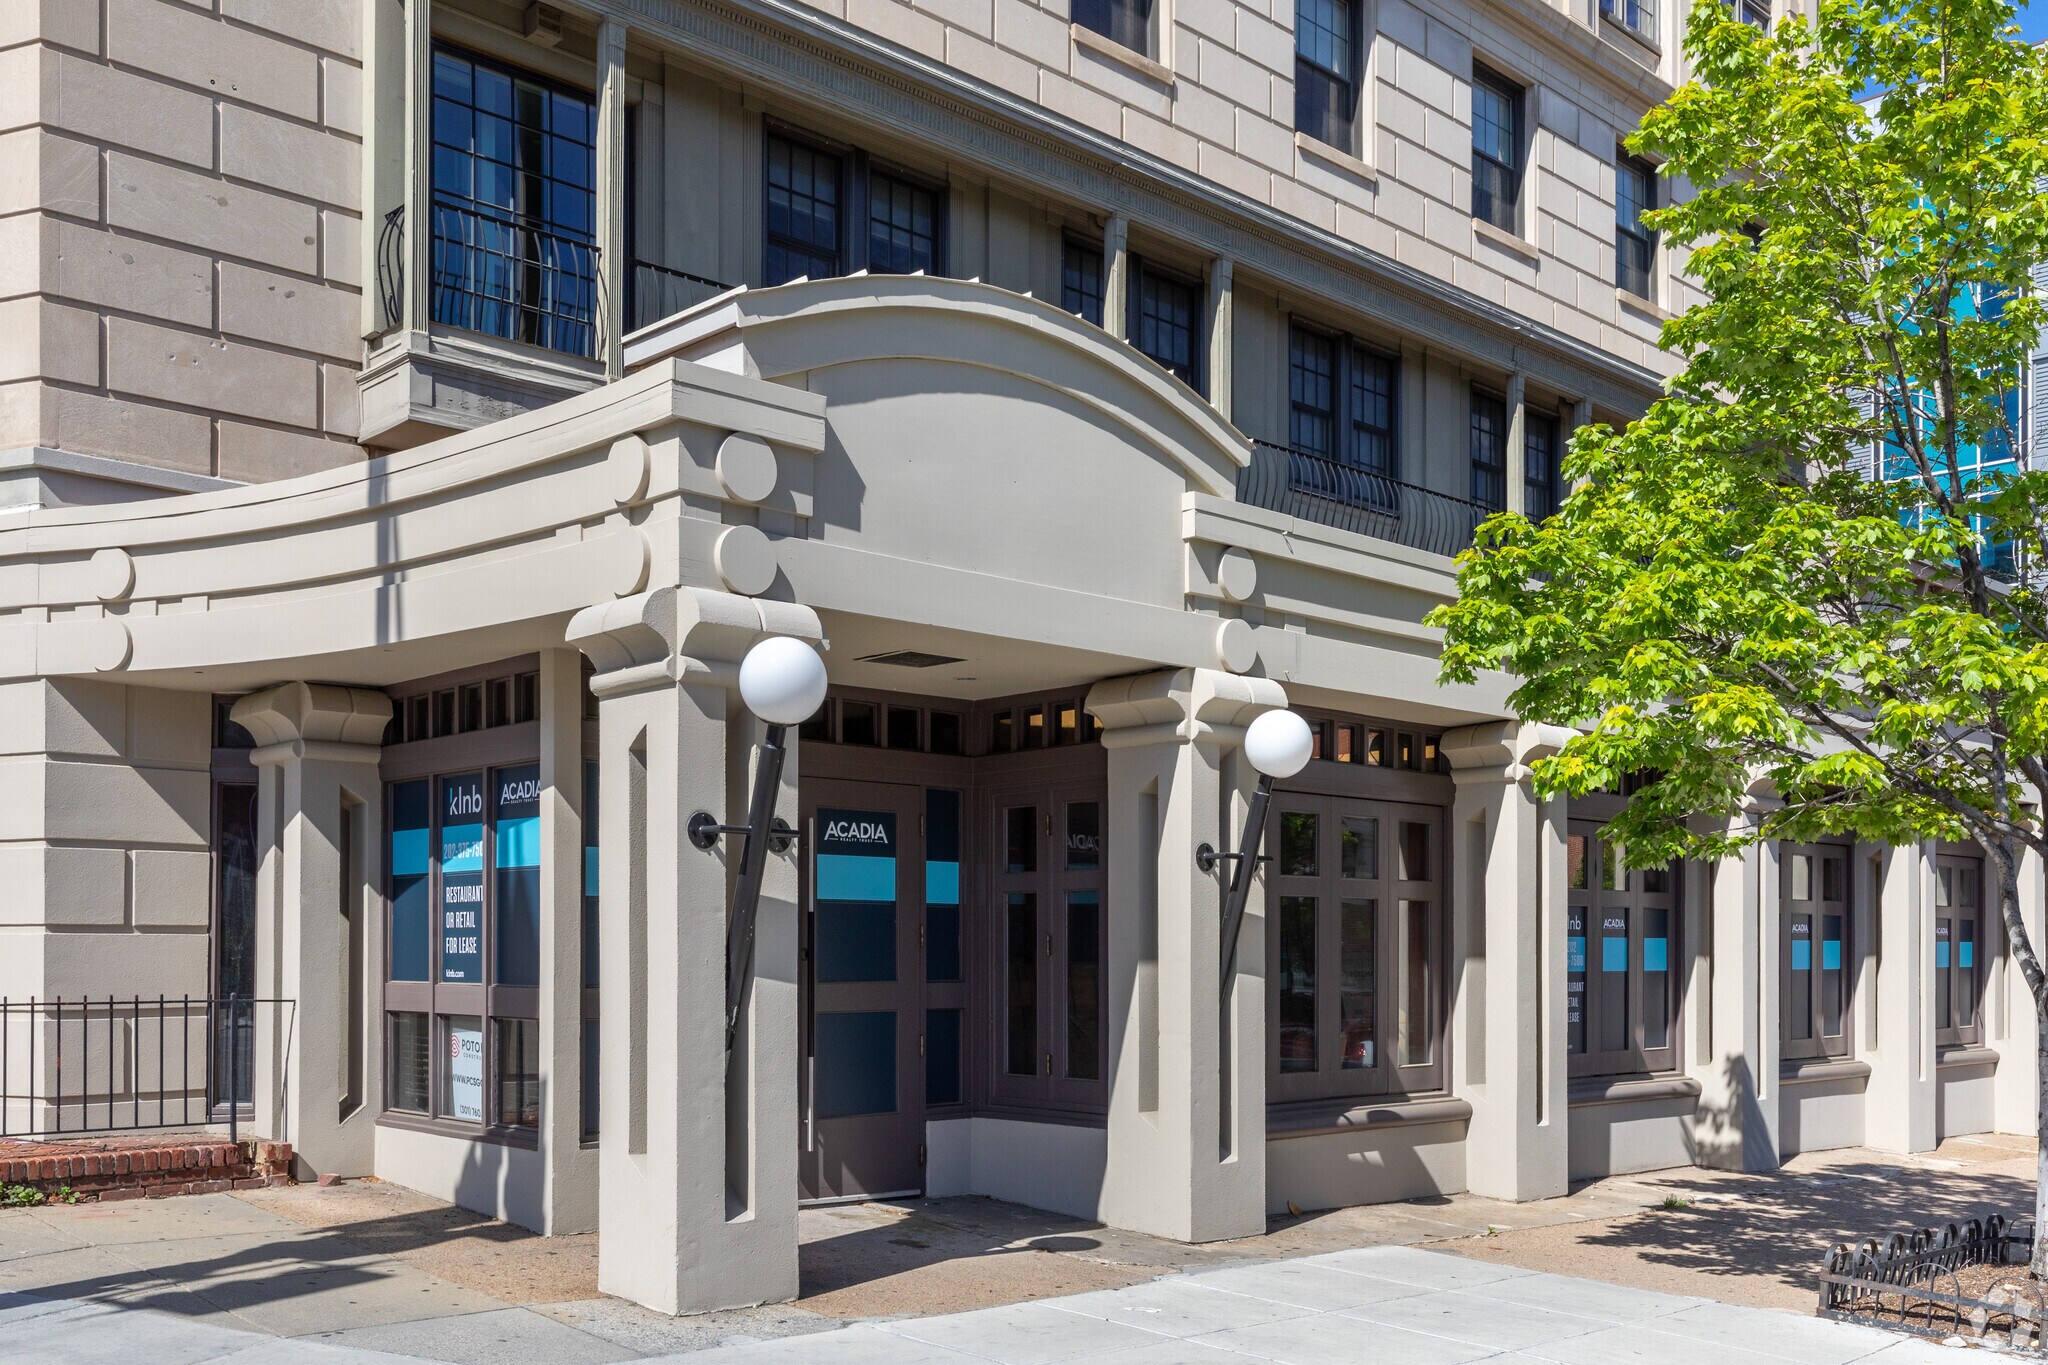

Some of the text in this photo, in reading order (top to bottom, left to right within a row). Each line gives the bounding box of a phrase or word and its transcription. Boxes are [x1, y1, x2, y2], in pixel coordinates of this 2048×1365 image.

[449, 784, 482, 816] klnb
[500, 780, 541, 805] ACADIA
[824, 821, 888, 844] ACADIA
[445, 885, 484, 903] RESTAURANT
[445, 911, 476, 929] OR RETAIL
[1603, 918, 1626, 930] ACADIA
[1791, 923, 1809, 934] ACADIA
[445, 937, 477, 954] FOR LEASE
[1568, 954, 1584, 966] -7500
[461, 1038, 482, 1053] POTO
